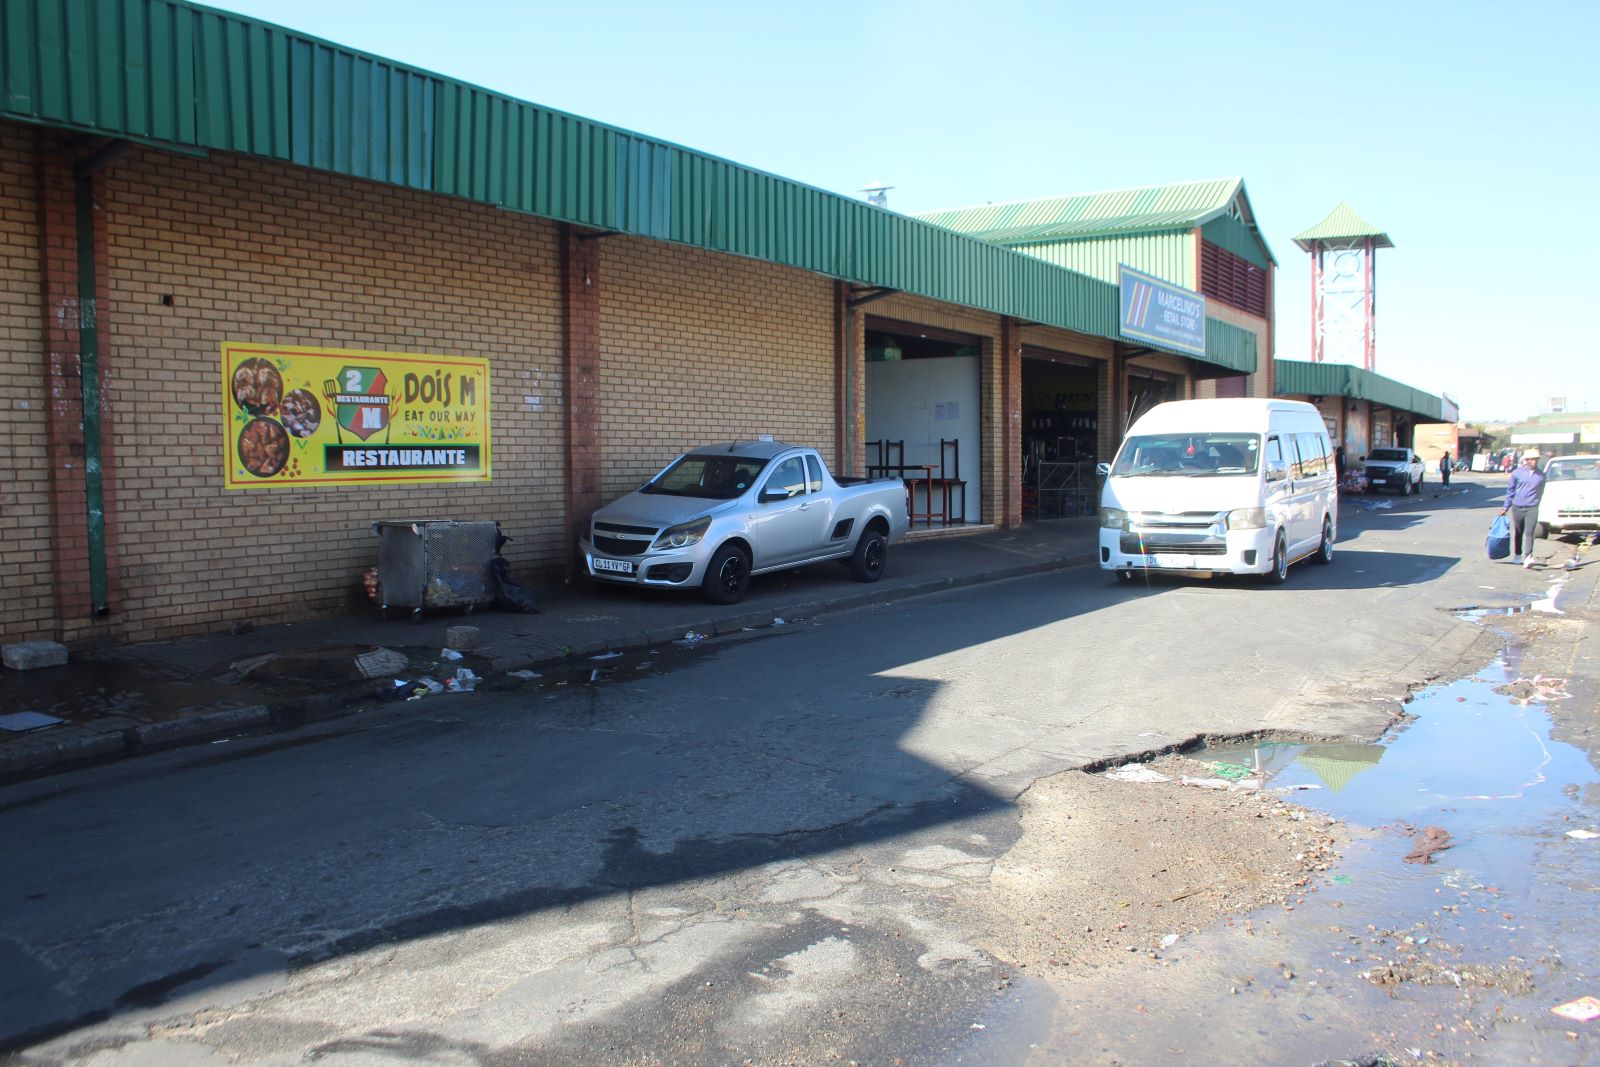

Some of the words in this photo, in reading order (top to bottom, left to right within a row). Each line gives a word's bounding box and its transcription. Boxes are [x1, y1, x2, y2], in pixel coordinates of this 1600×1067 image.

[346, 370, 362, 391] 2
[336, 395, 388, 404] RESTAURANTE
[460, 375, 475, 406] M
[362, 408, 382, 429] M
[404, 410, 425, 422] EAT
[429, 410, 450, 422] OUR
[455, 410, 477, 423] WAY
[343, 449, 465, 467] RESTAURANTE
[622, 562, 630, 571] GP
